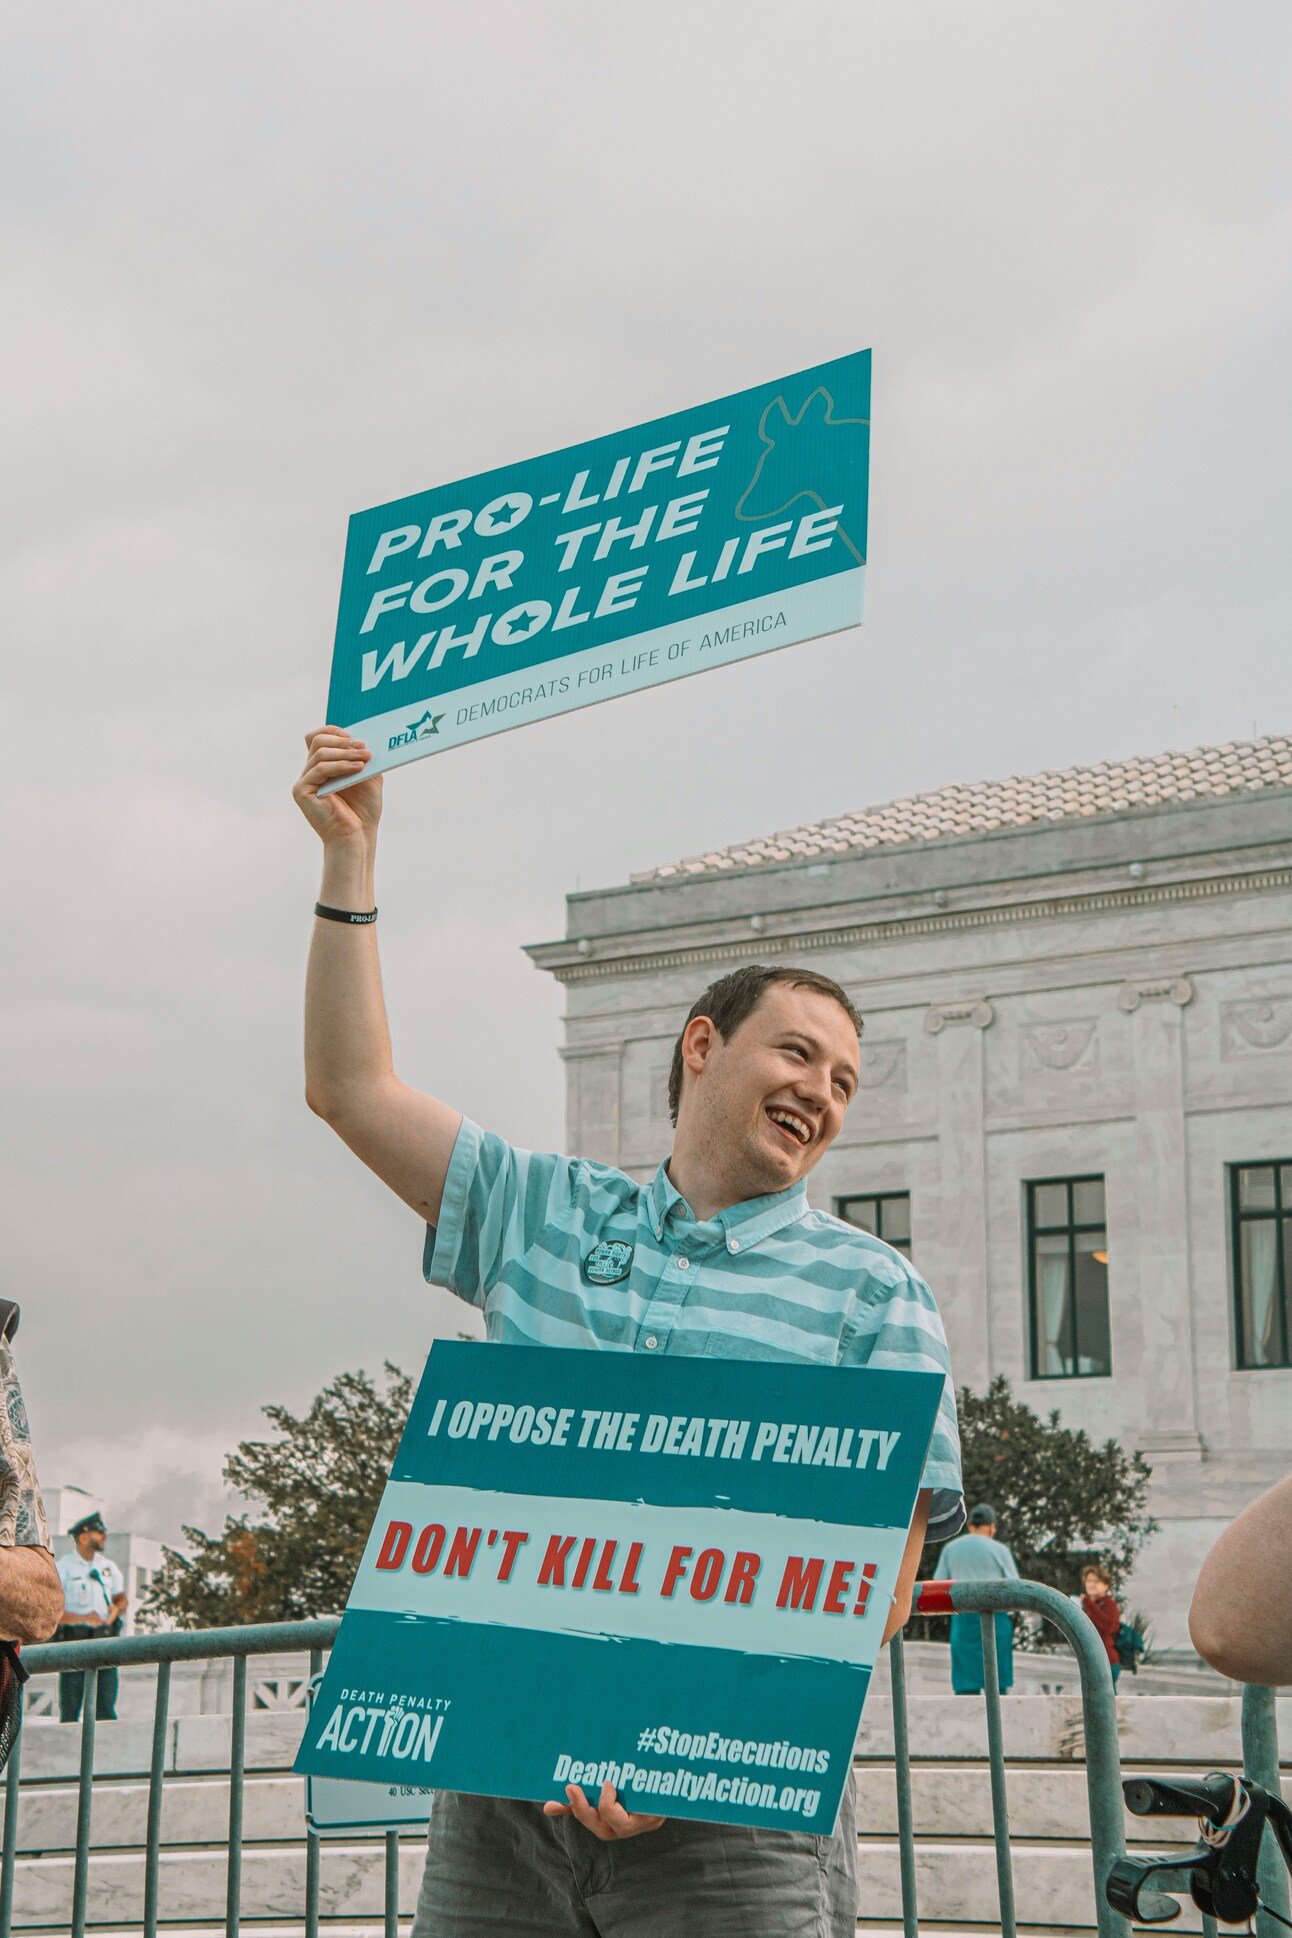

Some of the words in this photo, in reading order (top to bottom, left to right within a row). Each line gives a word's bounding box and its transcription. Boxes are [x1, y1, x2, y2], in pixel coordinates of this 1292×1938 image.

[366, 425, 730, 575] PRO-LIFE
[359, 550, 524, 635] FOR
[554, 489, 710, 572] THE
[361, 565, 649, 692] WHOLE
[668, 505, 844, 596] LIFE
[456, 676, 570, 725] DEMOCRATS
[577, 663, 613, 688] FOR
[621, 649, 660, 675] LIFE
[668, 639, 692, 660] OF
[699, 612, 787, 651] AMERICA
[388, 730, 417, 749] DFLA
[428, 1400, 447, 1437] I
[448, 1401, 573, 1446] OPPOSE
[577, 1410, 641, 1451] THE
[640, 1415, 752, 1459] DEATH
[751, 1423, 901, 1471] PENALTY
[375, 1521, 528, 1582] DON'T
[537, 1535, 644, 1594] KILL
[660, 1546, 761, 1605] FOR
[775, 1556, 878, 1617] ME!
[315, 1704, 444, 1762] ACTION
[340, 1688, 385, 1704] DEATH
[389, 1694, 451, 1711] PENALTY
[553, 1754, 821, 1817] DeathPenaltyAction.org
[637, 1726, 830, 1774] #StopExecutions
